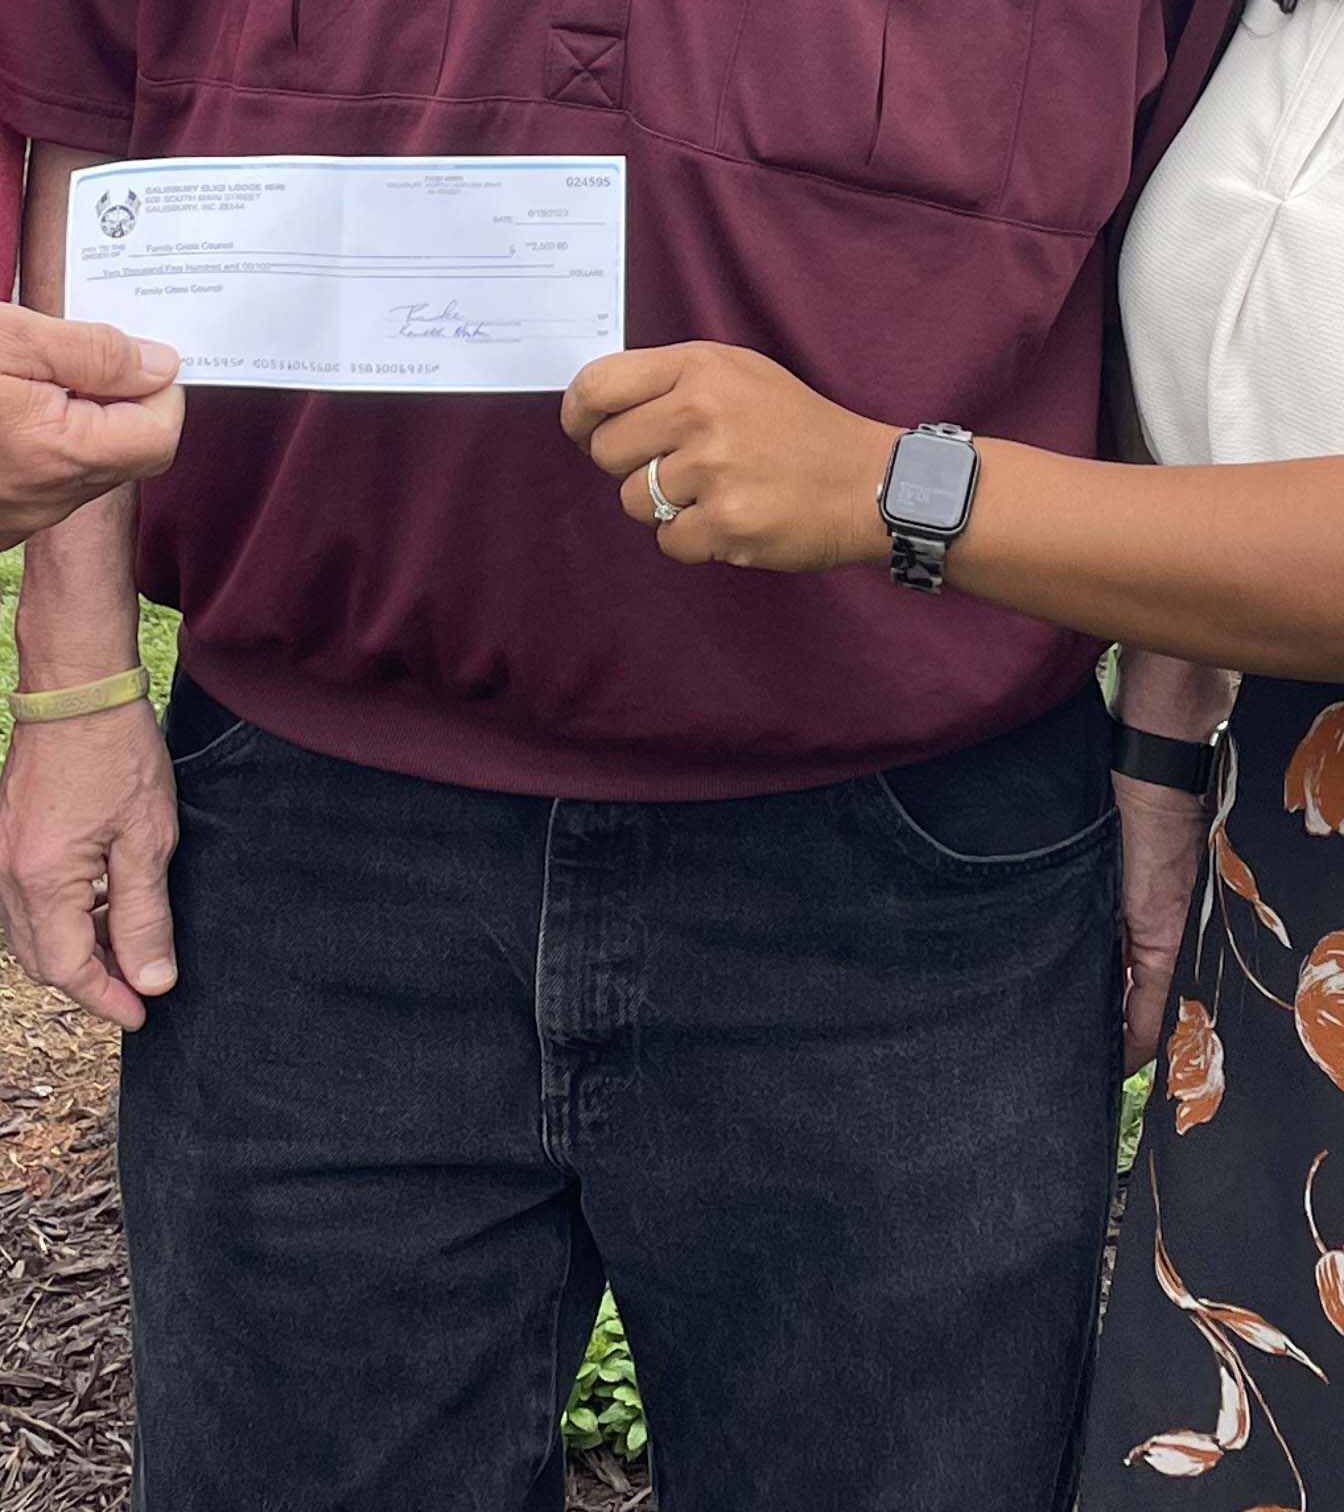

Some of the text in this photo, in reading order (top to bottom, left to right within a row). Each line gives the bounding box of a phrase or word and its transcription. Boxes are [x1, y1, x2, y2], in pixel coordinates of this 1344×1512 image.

[565, 176, 611, 189] 024595
[146, 244, 173, 255] Family
[134, 286, 164, 296] Family
